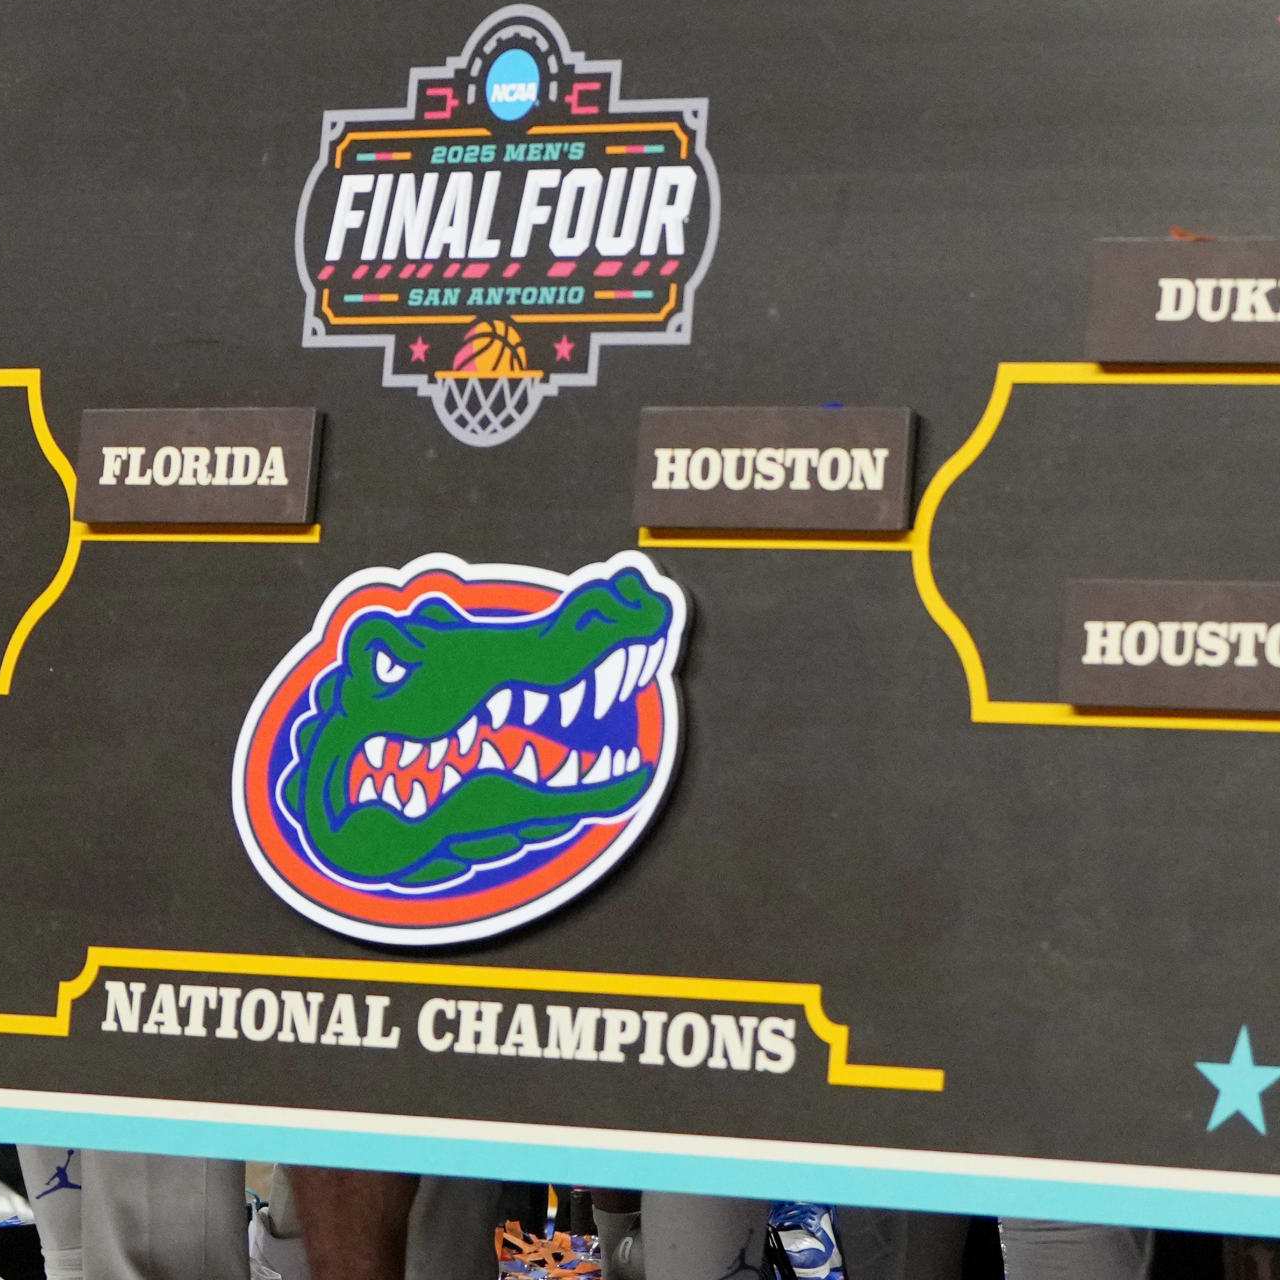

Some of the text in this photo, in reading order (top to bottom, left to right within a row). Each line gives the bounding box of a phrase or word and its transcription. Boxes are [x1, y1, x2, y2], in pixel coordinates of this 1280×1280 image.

[491, 81, 538, 104] NCAA
[430, 141, 586, 165] 2025 MEN'S
[324, 165, 698, 262] FINAL FOUR
[407, 285, 586, 307] SAN ANTONIO
[98, 445, 289, 487] FLORIDA
[651, 446, 889, 492] HOUSTON
[101, 980, 798, 1075] NATIONAL CHAMPIONS
